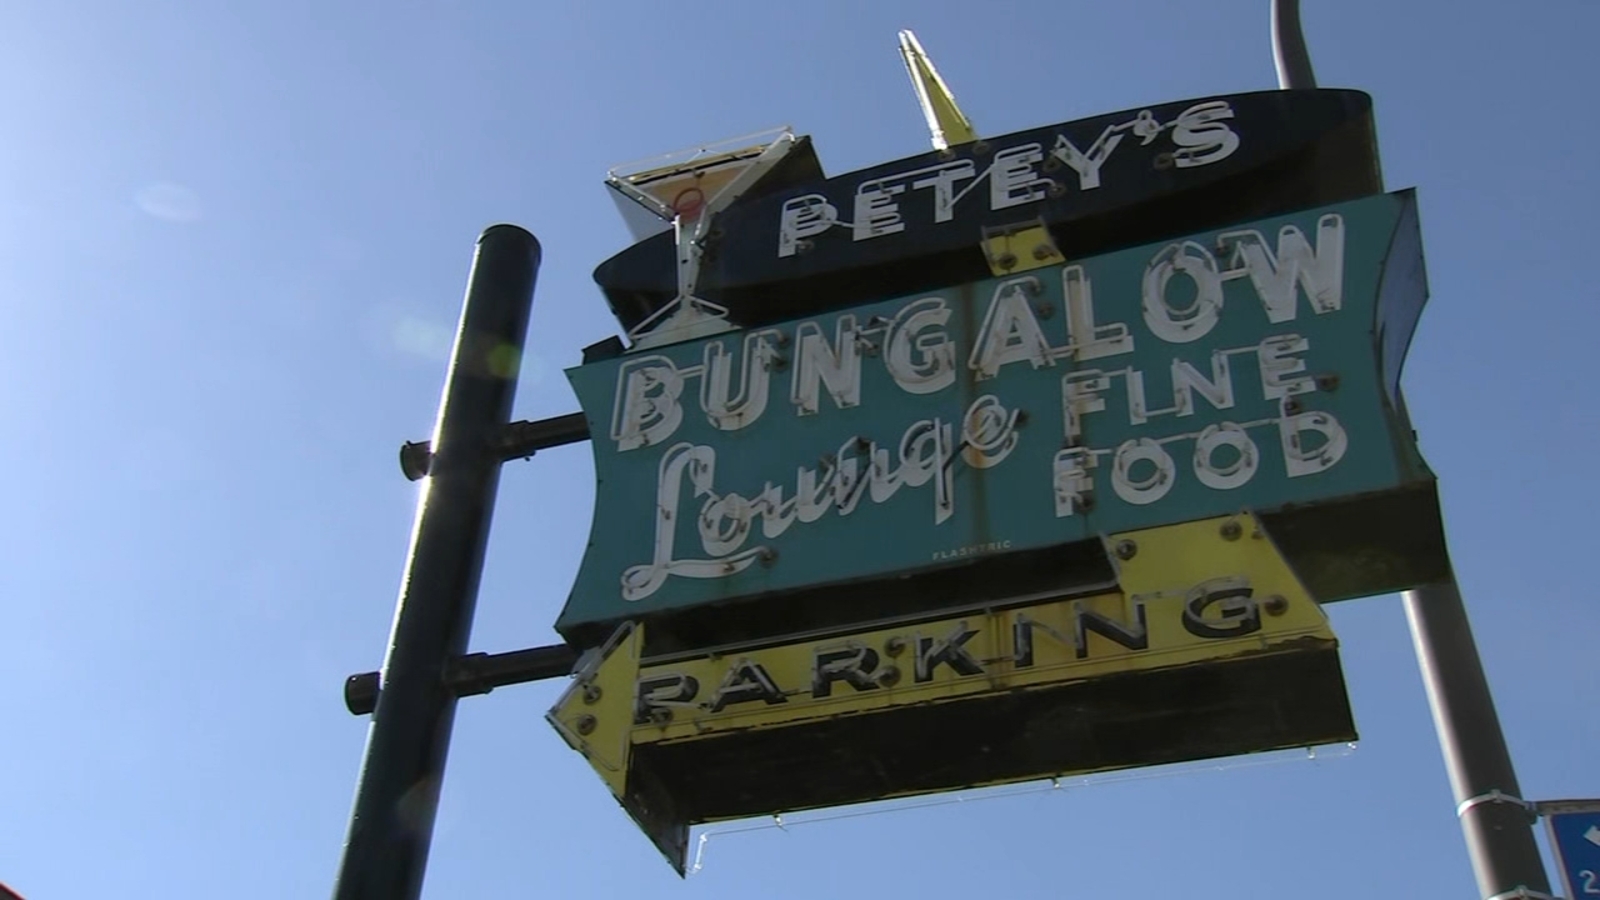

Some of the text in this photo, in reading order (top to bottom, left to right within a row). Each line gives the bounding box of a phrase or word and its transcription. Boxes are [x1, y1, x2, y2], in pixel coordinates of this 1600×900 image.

[778, 101, 1240, 258] PETEY'S
[610, 213, 1345, 451] BUNGALOW
[1061, 333, 1317, 437] FINE
[621, 394, 1020, 601] Lounge
[1053, 408, 1348, 518] FOOD
[932, 539, 1012, 561] FLASHTRIC
[633, 576, 1263, 724] PARKING
